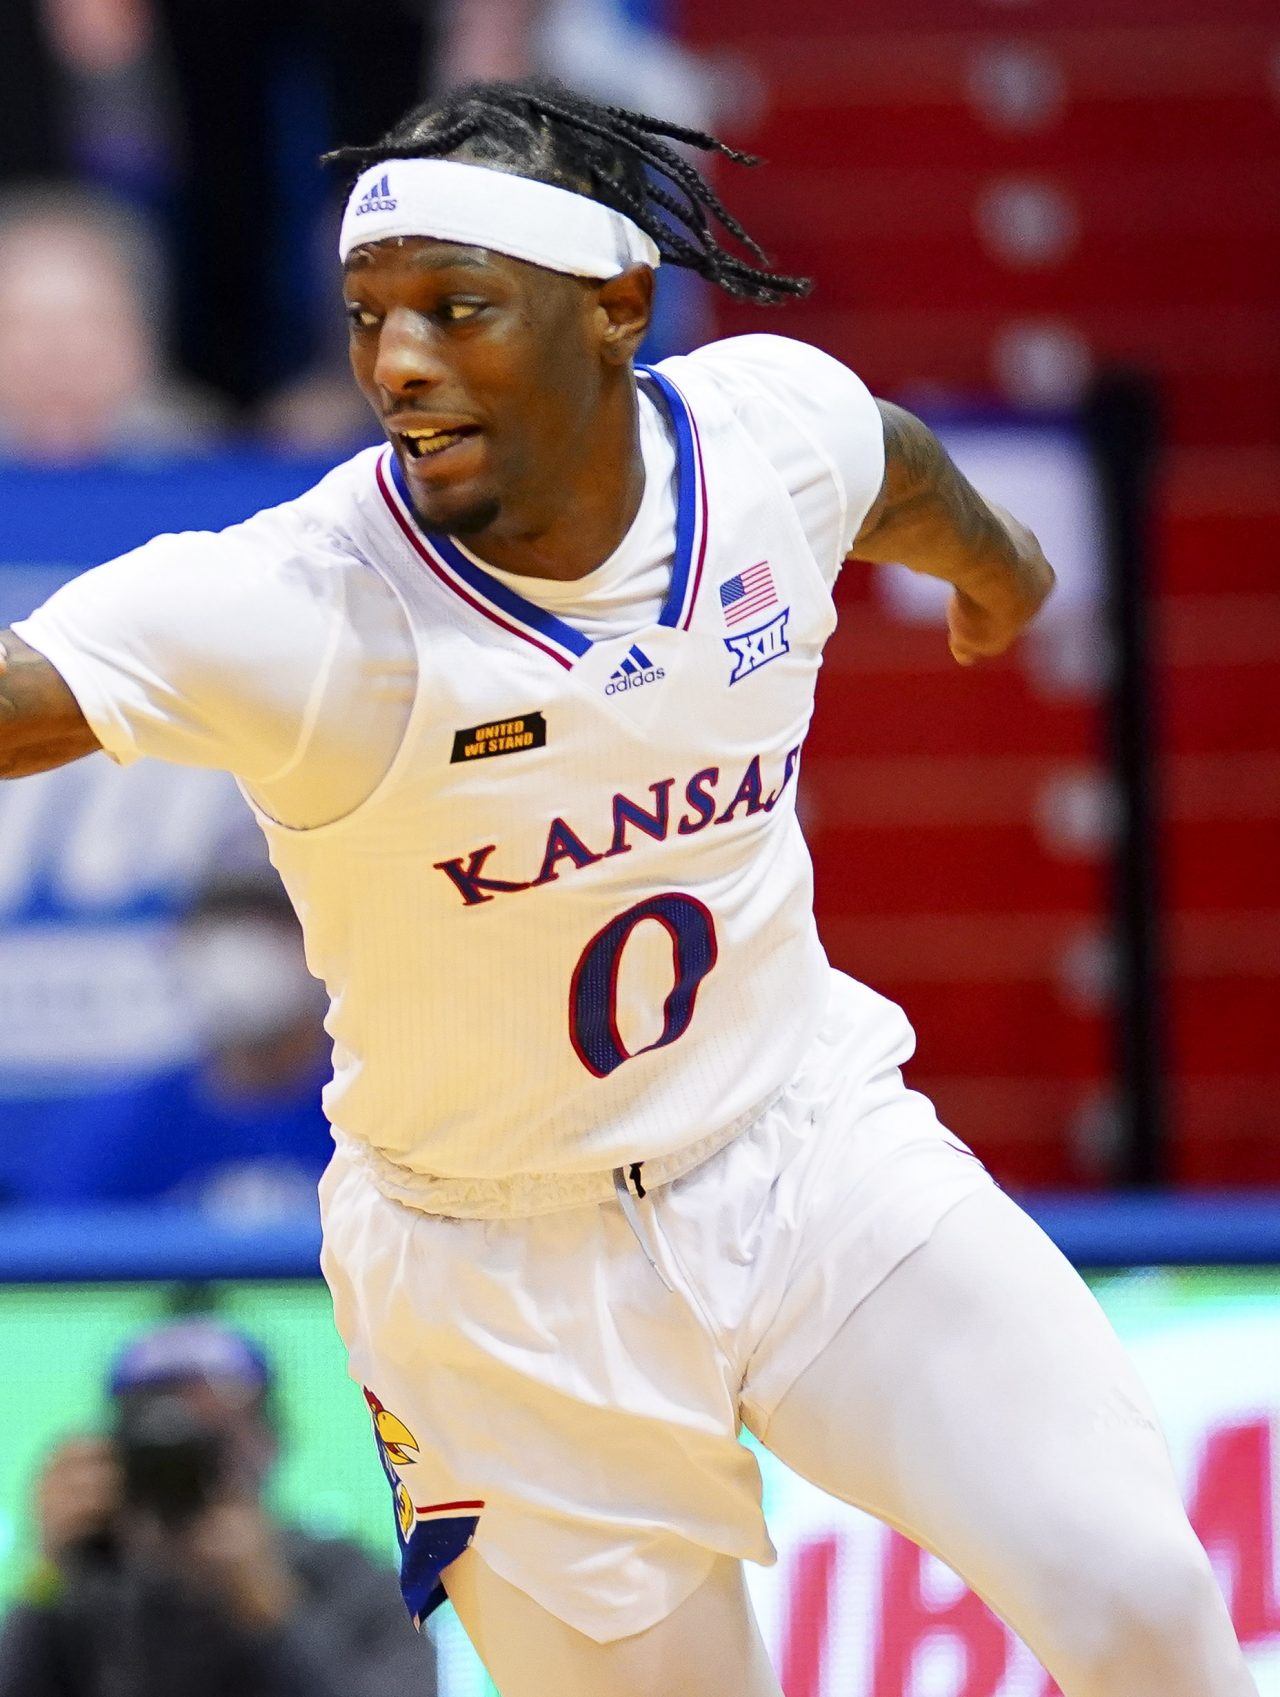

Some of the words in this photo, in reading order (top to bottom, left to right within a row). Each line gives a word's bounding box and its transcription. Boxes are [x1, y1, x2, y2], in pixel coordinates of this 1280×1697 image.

[604, 666, 667, 697] adidas
[464, 742, 486, 757] WE
[488, 732, 534, 752] STAND
[475, 720, 524, 741] UNITED
[568, 891, 719, 1079] 0
